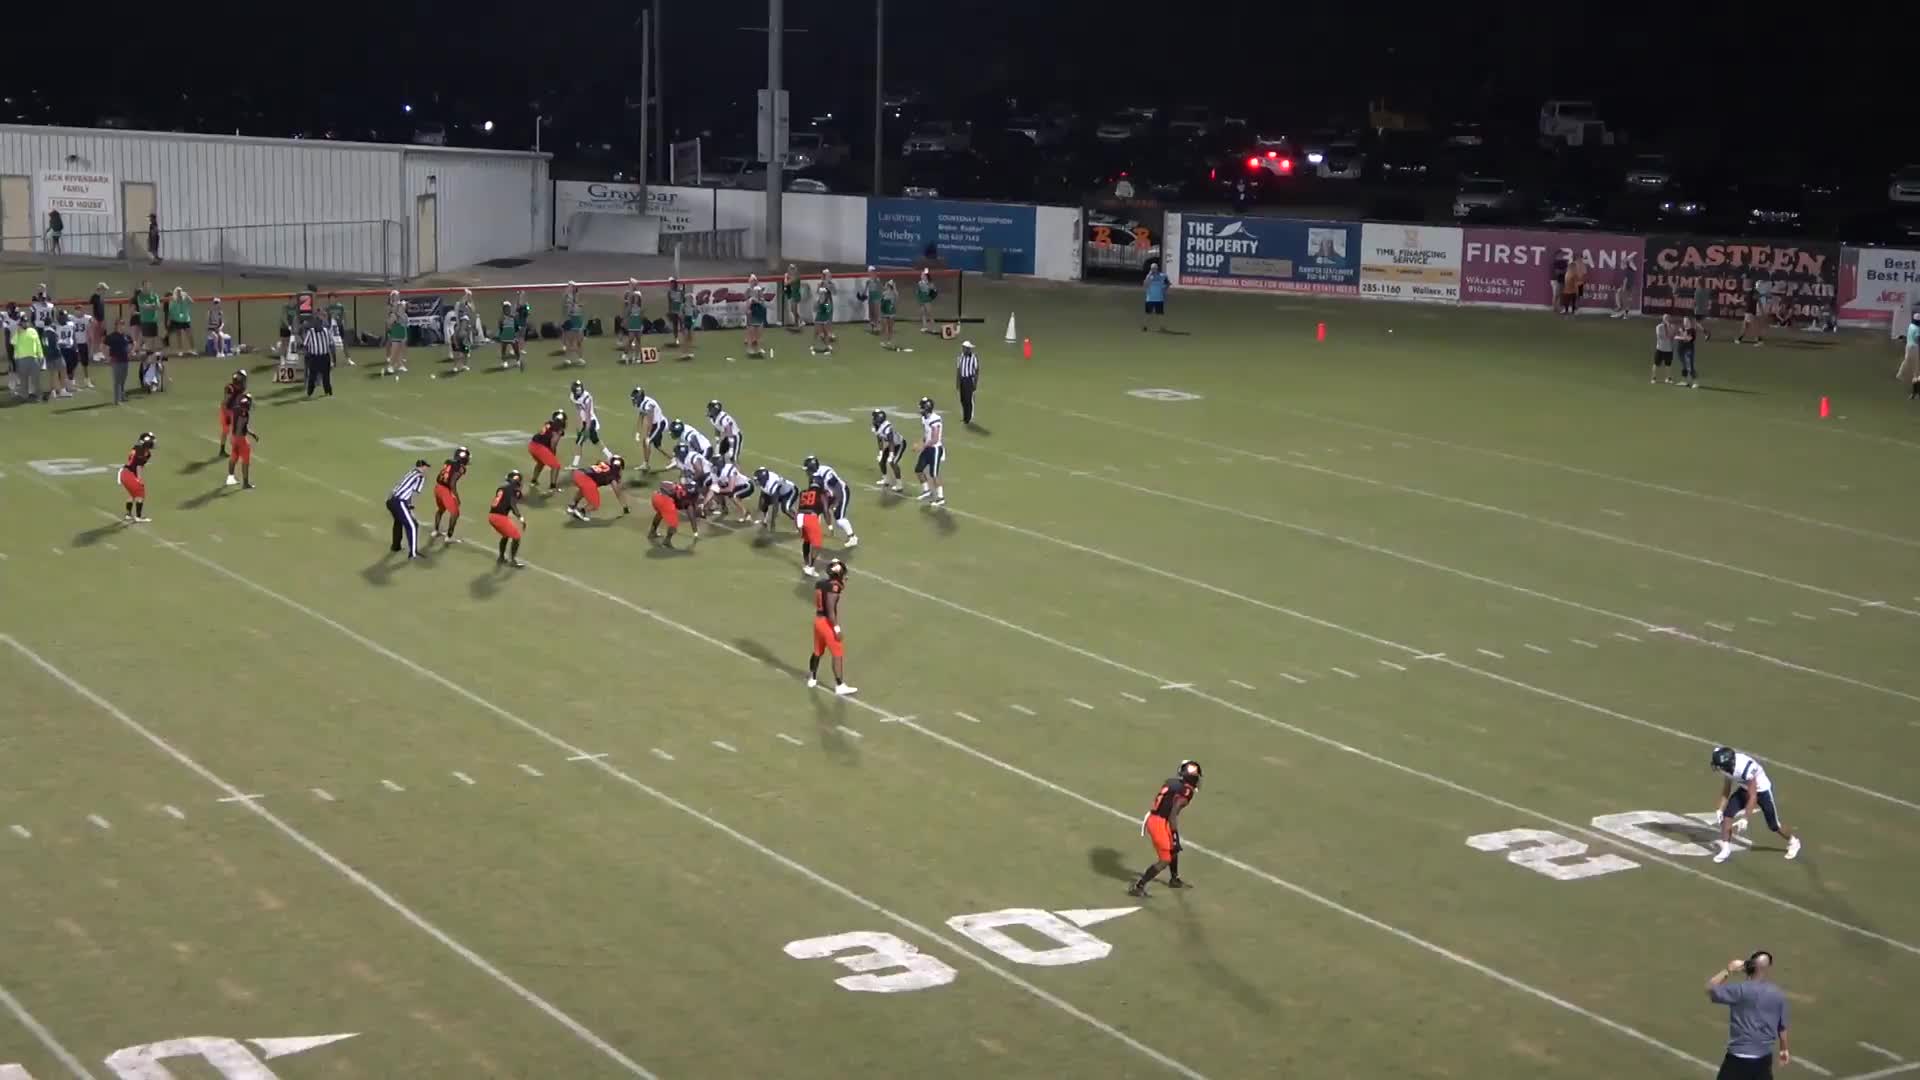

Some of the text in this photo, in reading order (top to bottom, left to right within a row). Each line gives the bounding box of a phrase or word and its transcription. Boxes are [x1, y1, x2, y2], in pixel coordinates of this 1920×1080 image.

[1187, 222, 1214, 236] THE
[1186, 237, 1259, 254] PROPERTY
[1186, 252, 1225, 267] SHOP
[1376, 248, 1447, 260] TIME FINANCING
[1392, 256, 1429, 265] SERVICE
[1466, 243, 1639, 271] FIRST BANK
[1656, 245, 1827, 274] CASTEEN
[1884, 257, 1916, 270] Best
[1866, 270, 1899, 281] Best
[1513, 278, 1526, 287] NC
[1446, 288, 1457, 296] NC
[644, 349, 656, 360] 10
[280, 368, 294, 380] 20
[1465, 810, 1752, 881] 20
[783, 907, 1113, 994] 30
